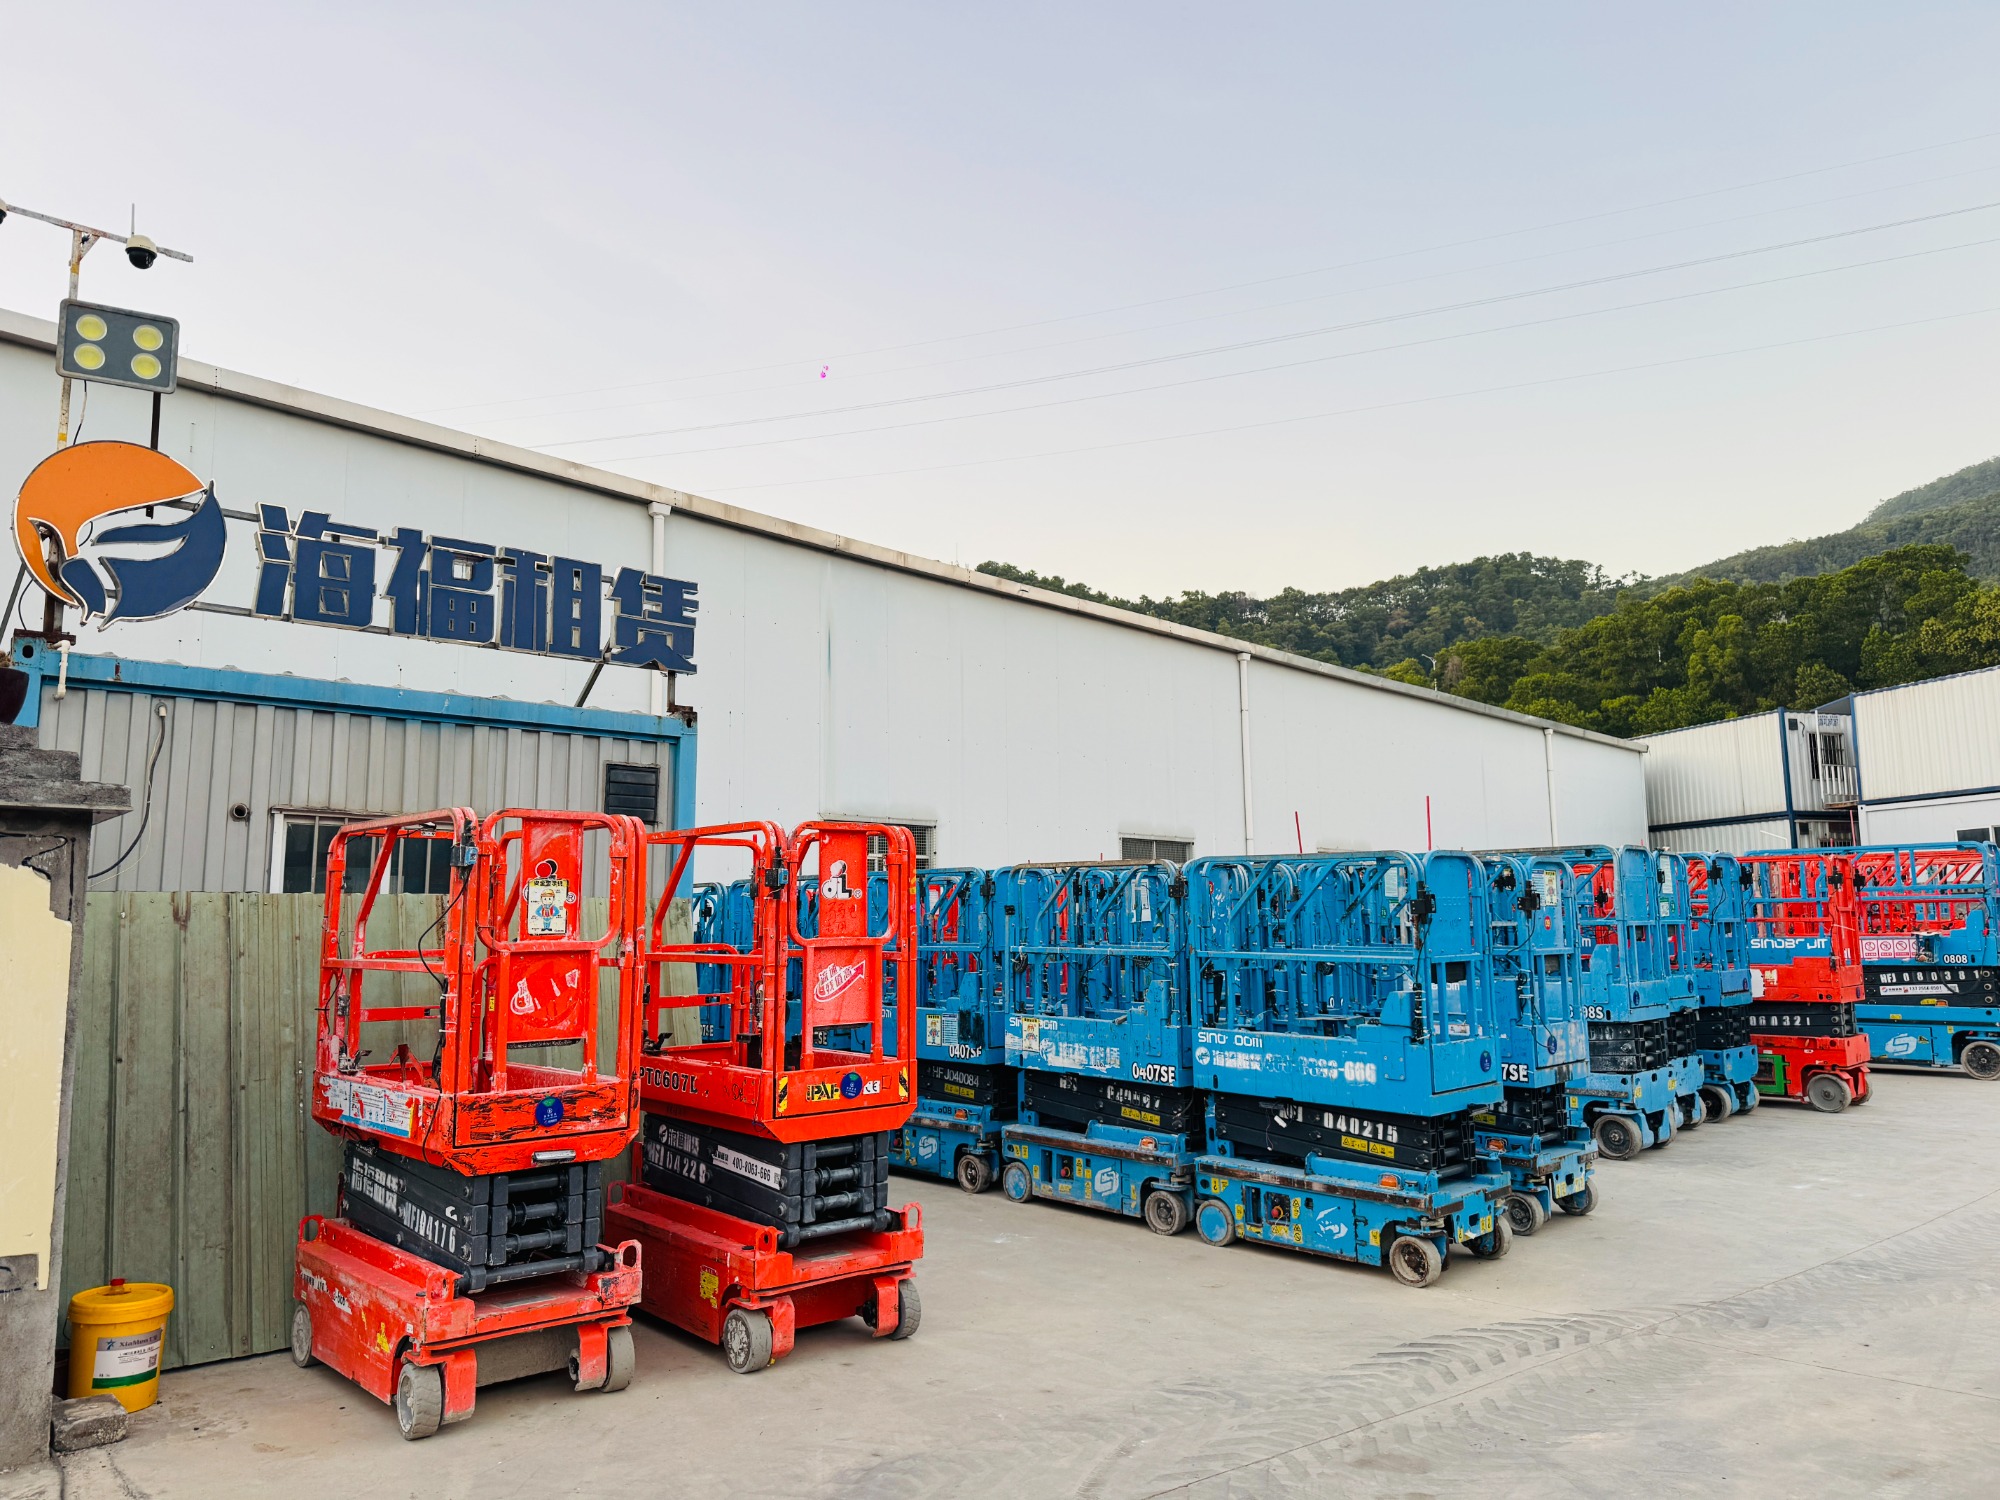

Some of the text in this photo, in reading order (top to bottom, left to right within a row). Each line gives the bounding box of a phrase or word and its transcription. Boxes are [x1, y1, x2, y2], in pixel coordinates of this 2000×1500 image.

[254, 501, 699, 676] 海福租赁
[1943, 954, 1968, 964] 0808
[1323, 1112, 1398, 1143] 040215
